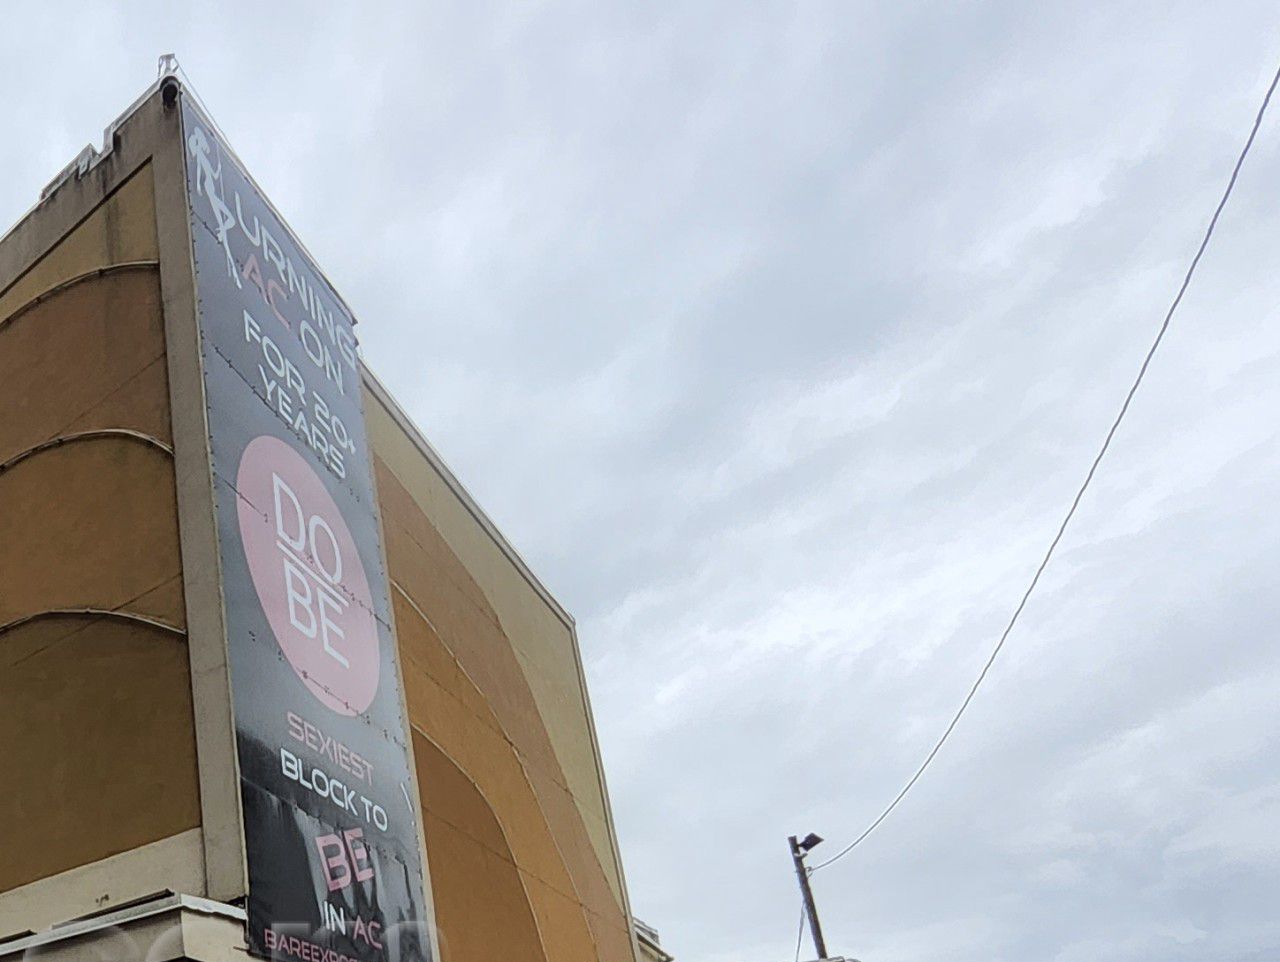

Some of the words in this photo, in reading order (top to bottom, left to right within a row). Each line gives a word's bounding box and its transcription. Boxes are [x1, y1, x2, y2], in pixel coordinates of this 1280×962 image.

[242, 253, 292, 329] AC
[299, 319, 345, 395] ON
[243, 309, 308, 407] FOR
[257, 364, 347, 480] YEARS
[272, 471, 343, 587] DO
[282, 557, 351, 670] BE
[280, 747, 359, 818] BLOCK
[359, 795, 389, 832] TO
[286, 710, 375, 787] SEXIEST
[315, 827, 376, 893] BE
[323, 899, 347, 937] IN
[351, 914, 383, 950] AC
